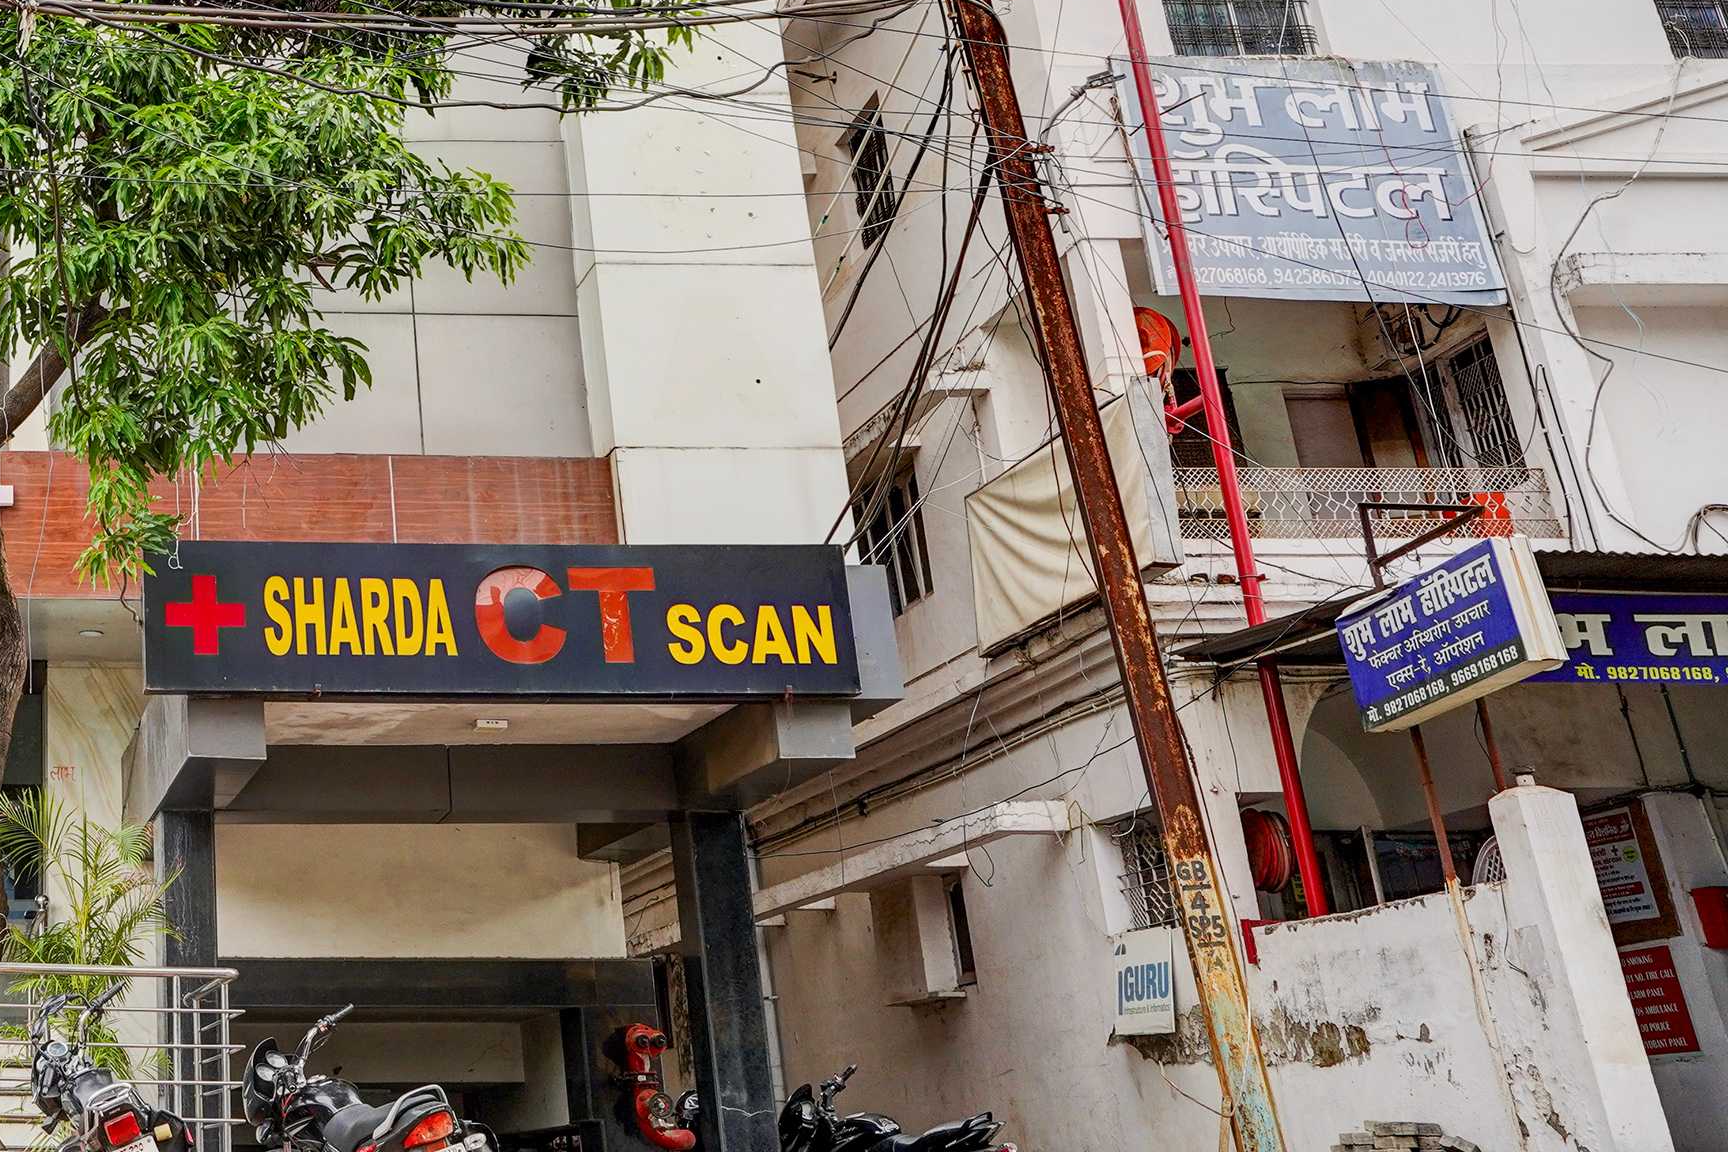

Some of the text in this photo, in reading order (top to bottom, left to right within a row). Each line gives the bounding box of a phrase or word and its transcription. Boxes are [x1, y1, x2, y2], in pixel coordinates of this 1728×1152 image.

[263, 564, 839, 666] SHARDA CT SCAN
[1175, 859, 1208, 881] GB
[1191, 890, 1211, 916] 4
